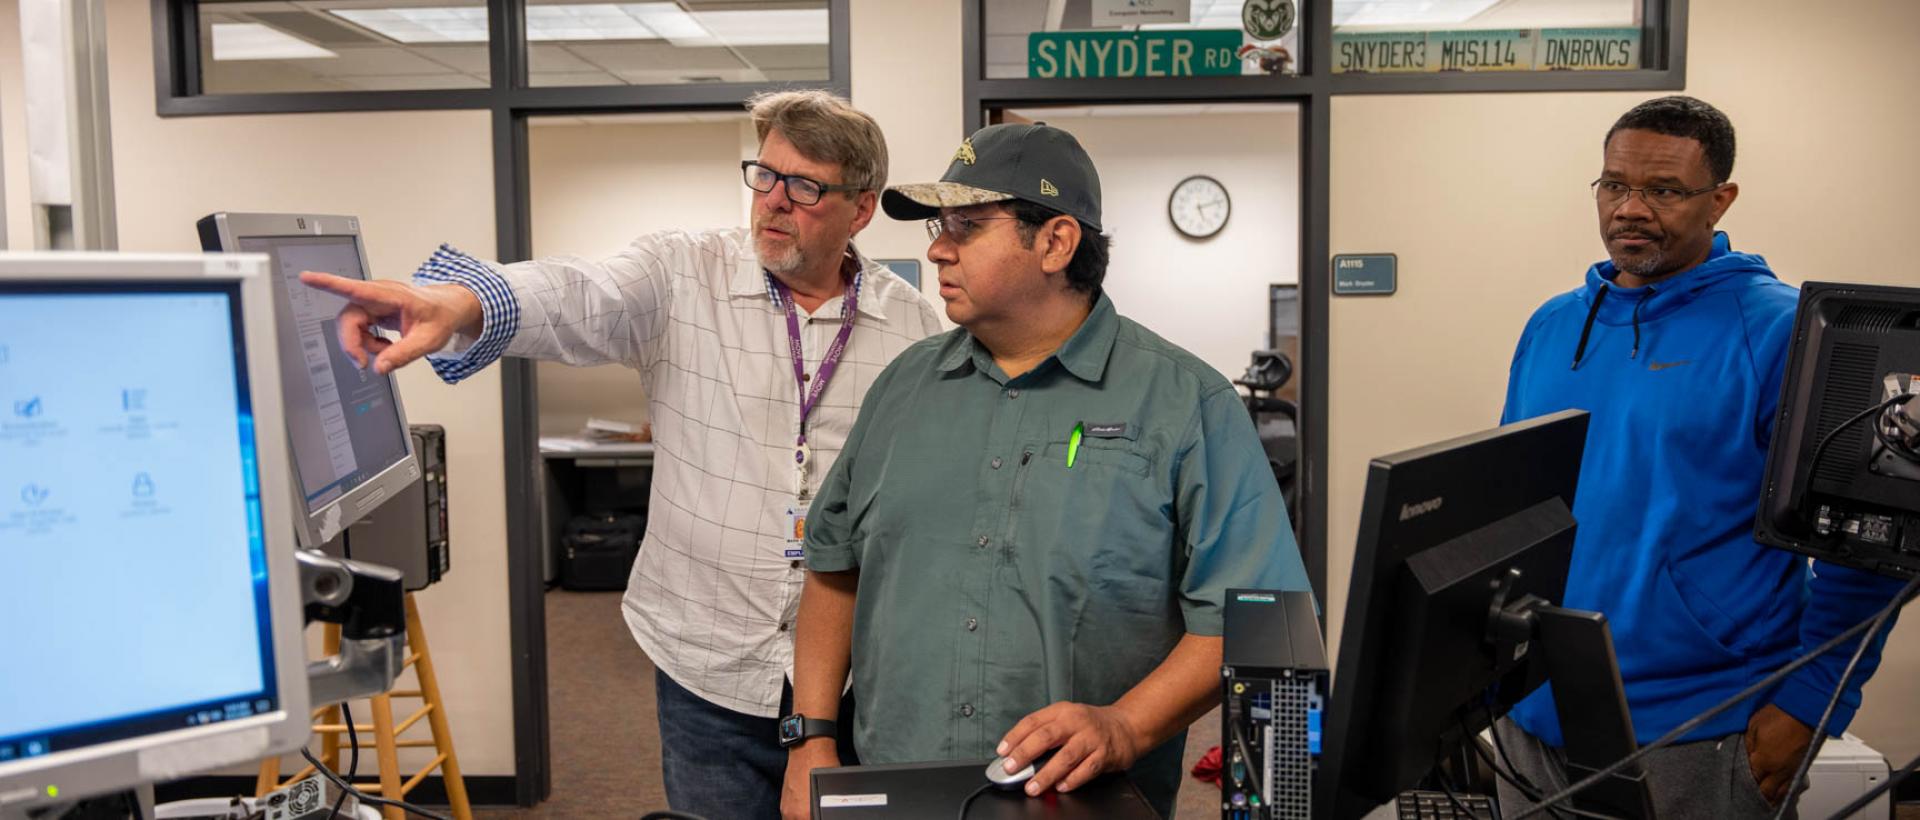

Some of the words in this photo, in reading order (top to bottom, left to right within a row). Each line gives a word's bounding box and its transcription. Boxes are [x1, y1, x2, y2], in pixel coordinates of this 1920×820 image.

[1037, 39, 1194, 77] SNYDER
[1205, 48, 1232, 69] RD
[1340, 41, 1425, 69] SNYDER3
[1441, 39, 1516, 67] MHS114
[1545, 38, 1631, 67] DNBRNCS
[830, 344, 844, 363] MOVE
[811, 378, 826, 398] MOVE
[1399, 496, 1443, 522] lenovo
